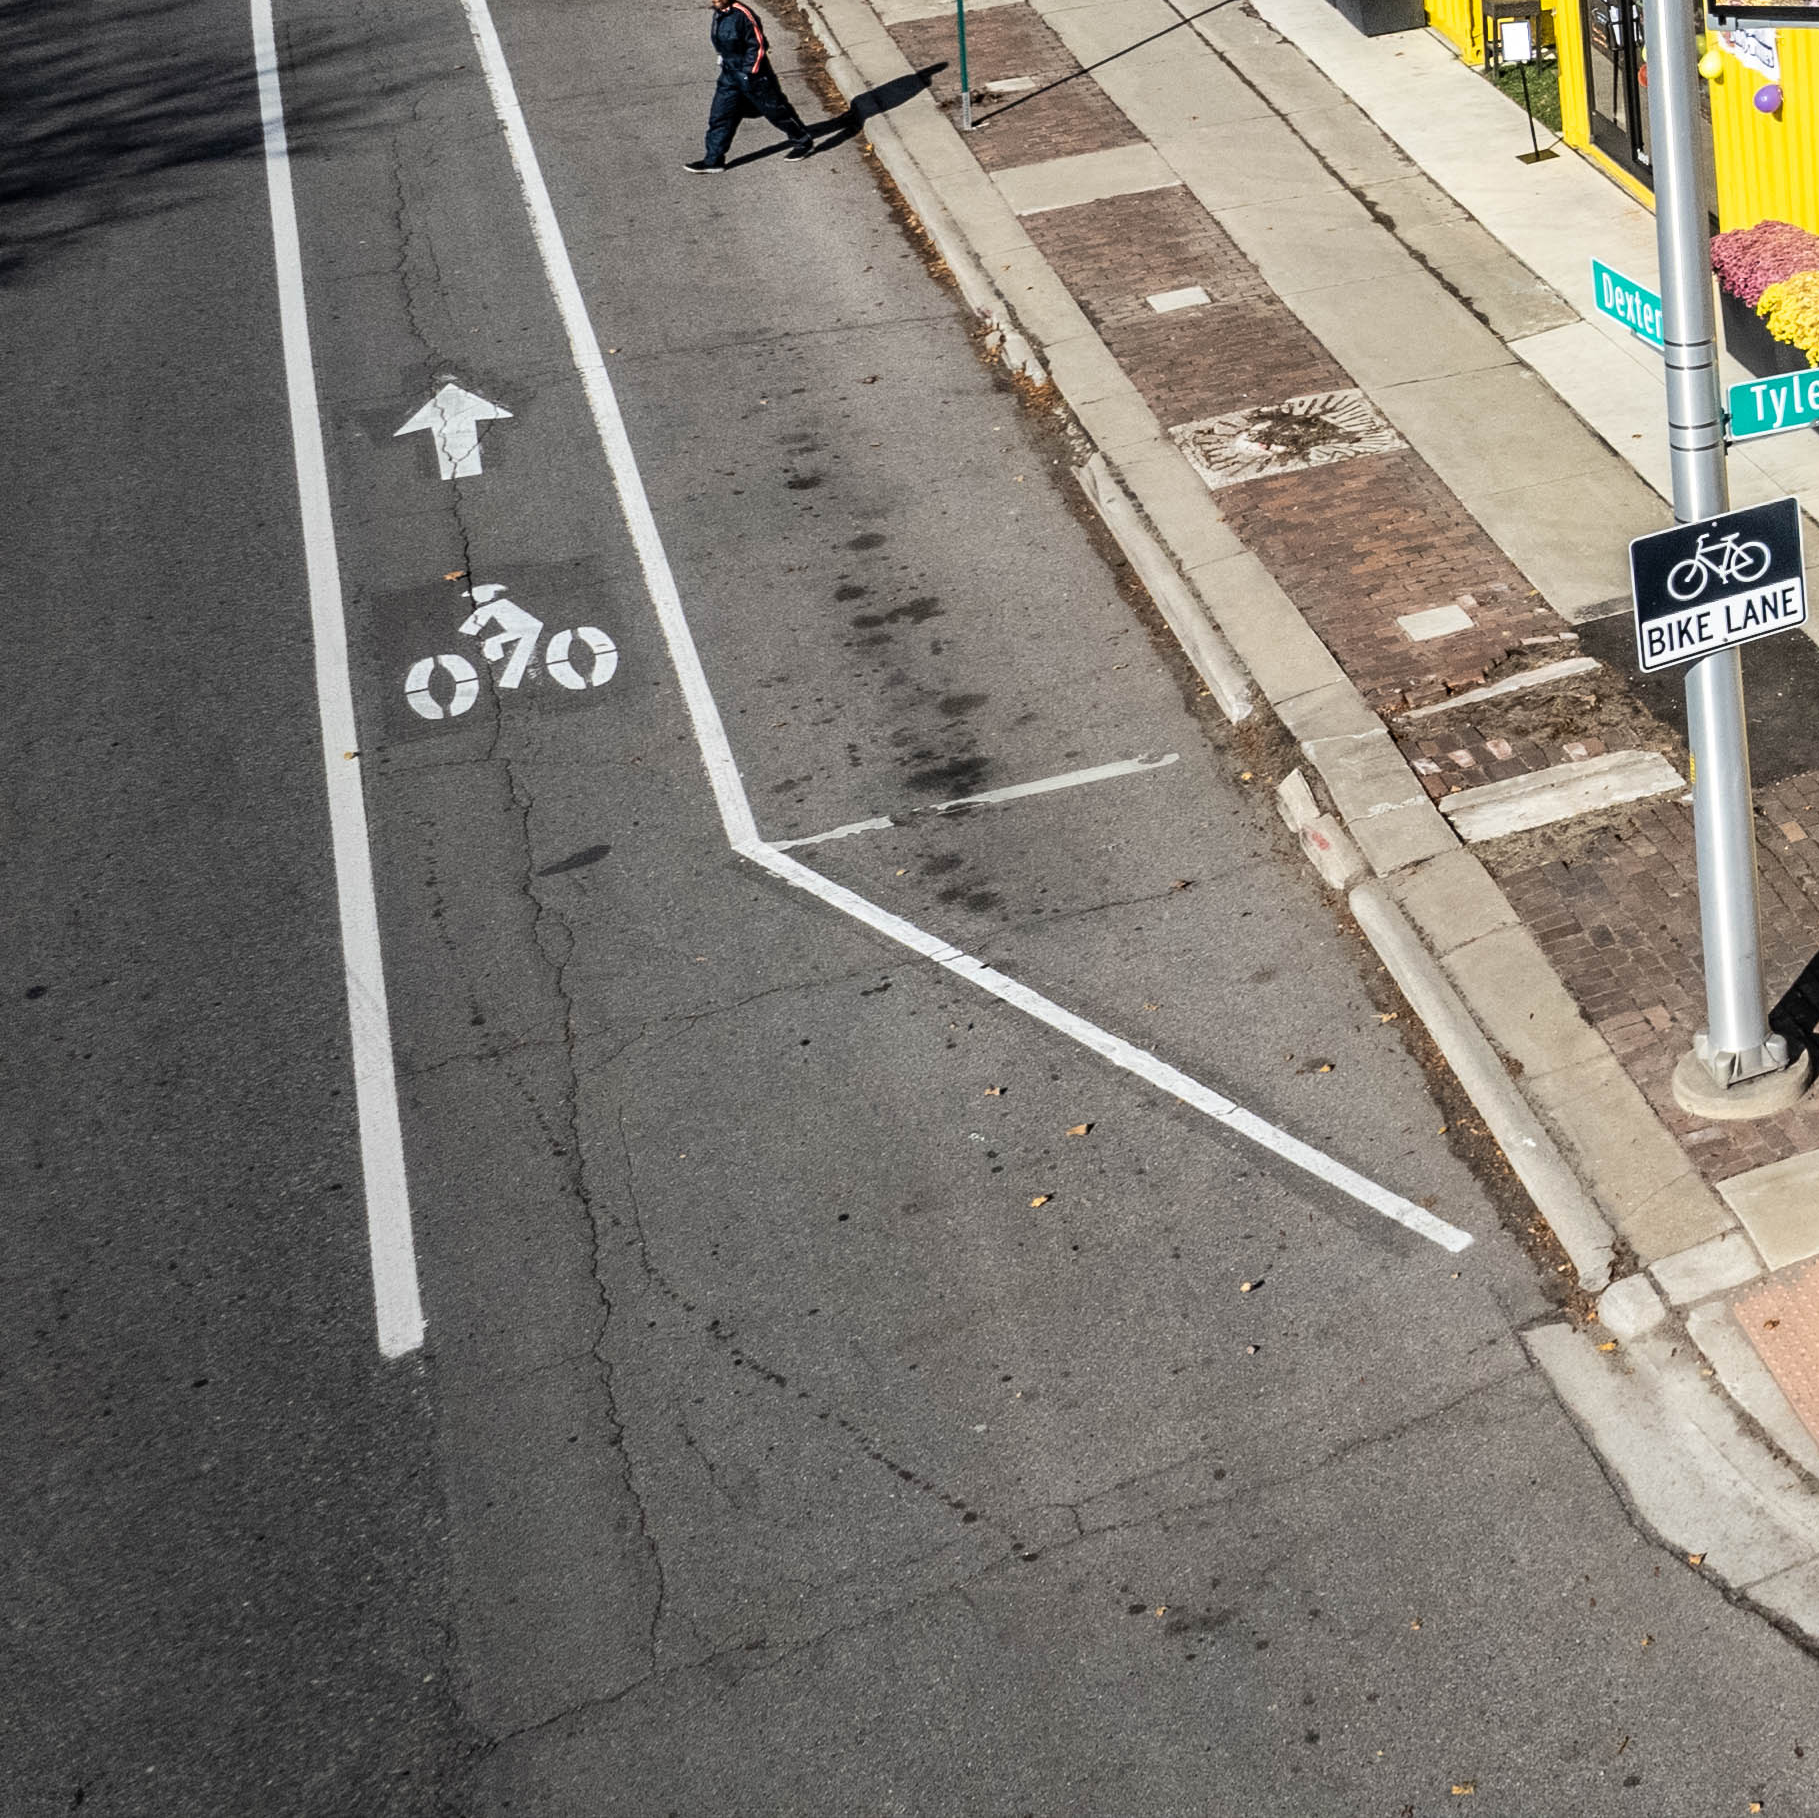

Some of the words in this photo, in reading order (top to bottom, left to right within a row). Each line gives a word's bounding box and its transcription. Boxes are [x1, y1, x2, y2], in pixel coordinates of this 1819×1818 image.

[1602, 271, 1665, 335] Dexter
[1648, 611, 1714, 658] BIKE
[1724, 586, 1798, 634] LANE
